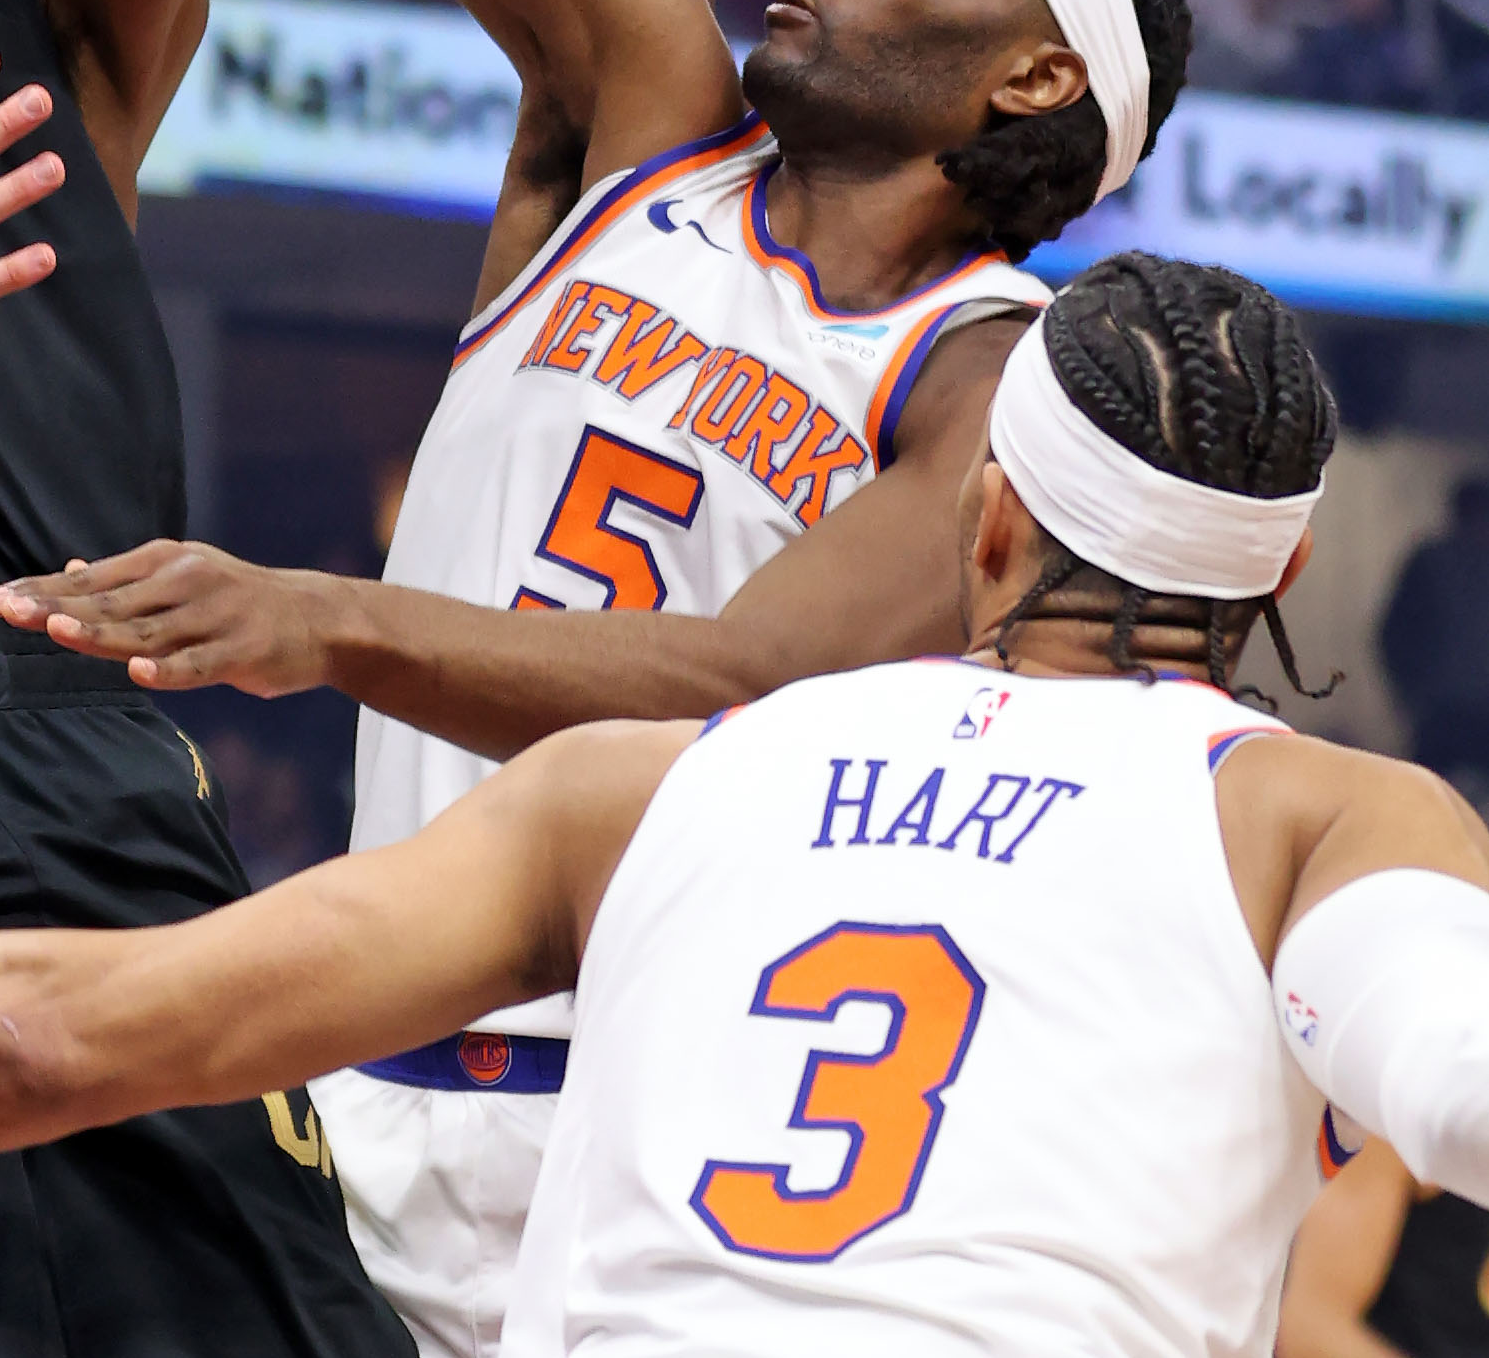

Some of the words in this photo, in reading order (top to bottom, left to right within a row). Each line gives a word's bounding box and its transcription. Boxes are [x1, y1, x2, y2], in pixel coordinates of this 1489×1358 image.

[1183, 128, 1485, 272] Locally
[514, 279, 710, 405] NEW
[665, 345, 869, 536] YORK
[511, 422, 705, 612] 5
[811, 759, 1085, 864] HART
[689, 920, 987, 1264] 3
